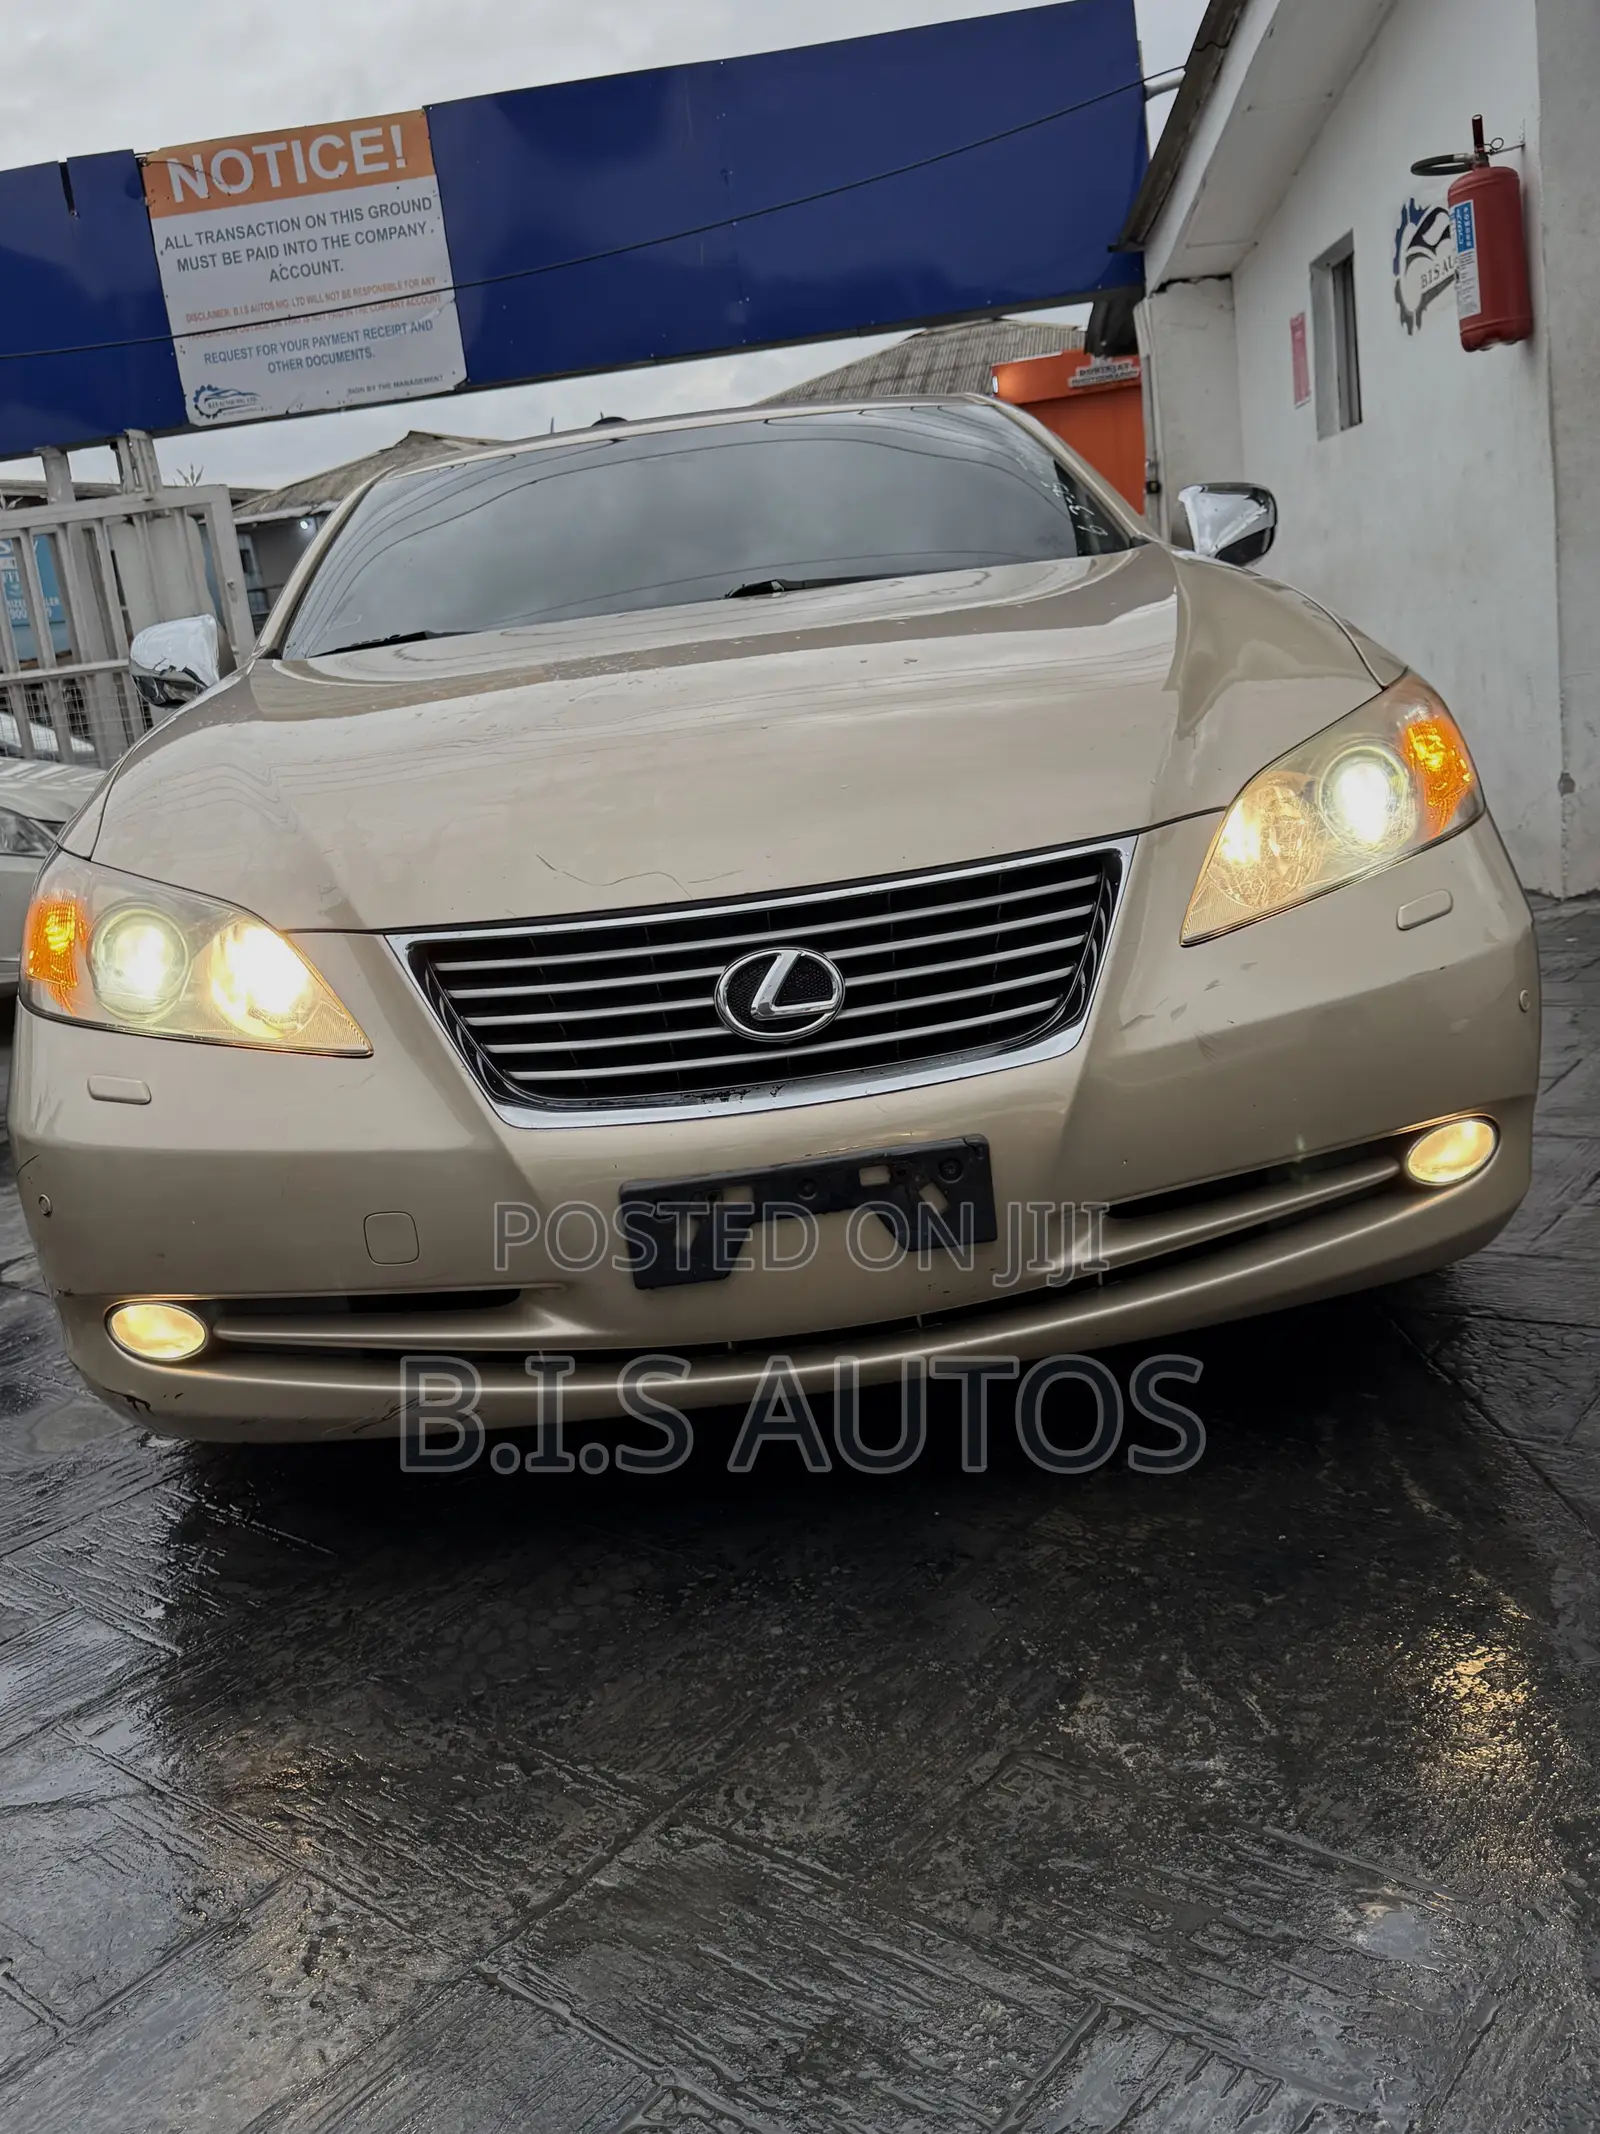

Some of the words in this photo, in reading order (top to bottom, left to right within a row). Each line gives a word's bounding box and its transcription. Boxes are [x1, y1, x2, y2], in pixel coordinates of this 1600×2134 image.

[166, 124, 407, 203] NOTICE!
[164, 234, 193, 251] ALL
[195, 216, 302, 247] TRANSACTION
[305, 212, 327, 229] ON
[330, 207, 365, 225] THIS
[368, 196, 433, 220] GROUND
[177, 253, 219, 273] MUST
[222, 250, 246, 266] BE
[246, 244, 280, 262] PAID
[283, 238, 318, 257] INTO
[321, 233, 352, 251] THE
[268, 258, 345, 283] ACCOUNT.
[420, 274, 436, 287] ANY
[204, 345, 254, 366] REQUEST
[255, 342, 279, 357] FOR
[279, 337, 310, 354] YOUR
[312, 330, 360, 348] PAYMENT
[362, 321, 408, 341] RECEIPT
[410, 318, 434, 334] AND
[267, 357, 304, 375] OTHER
[305, 347, 376, 369] DOCUMENTS.
